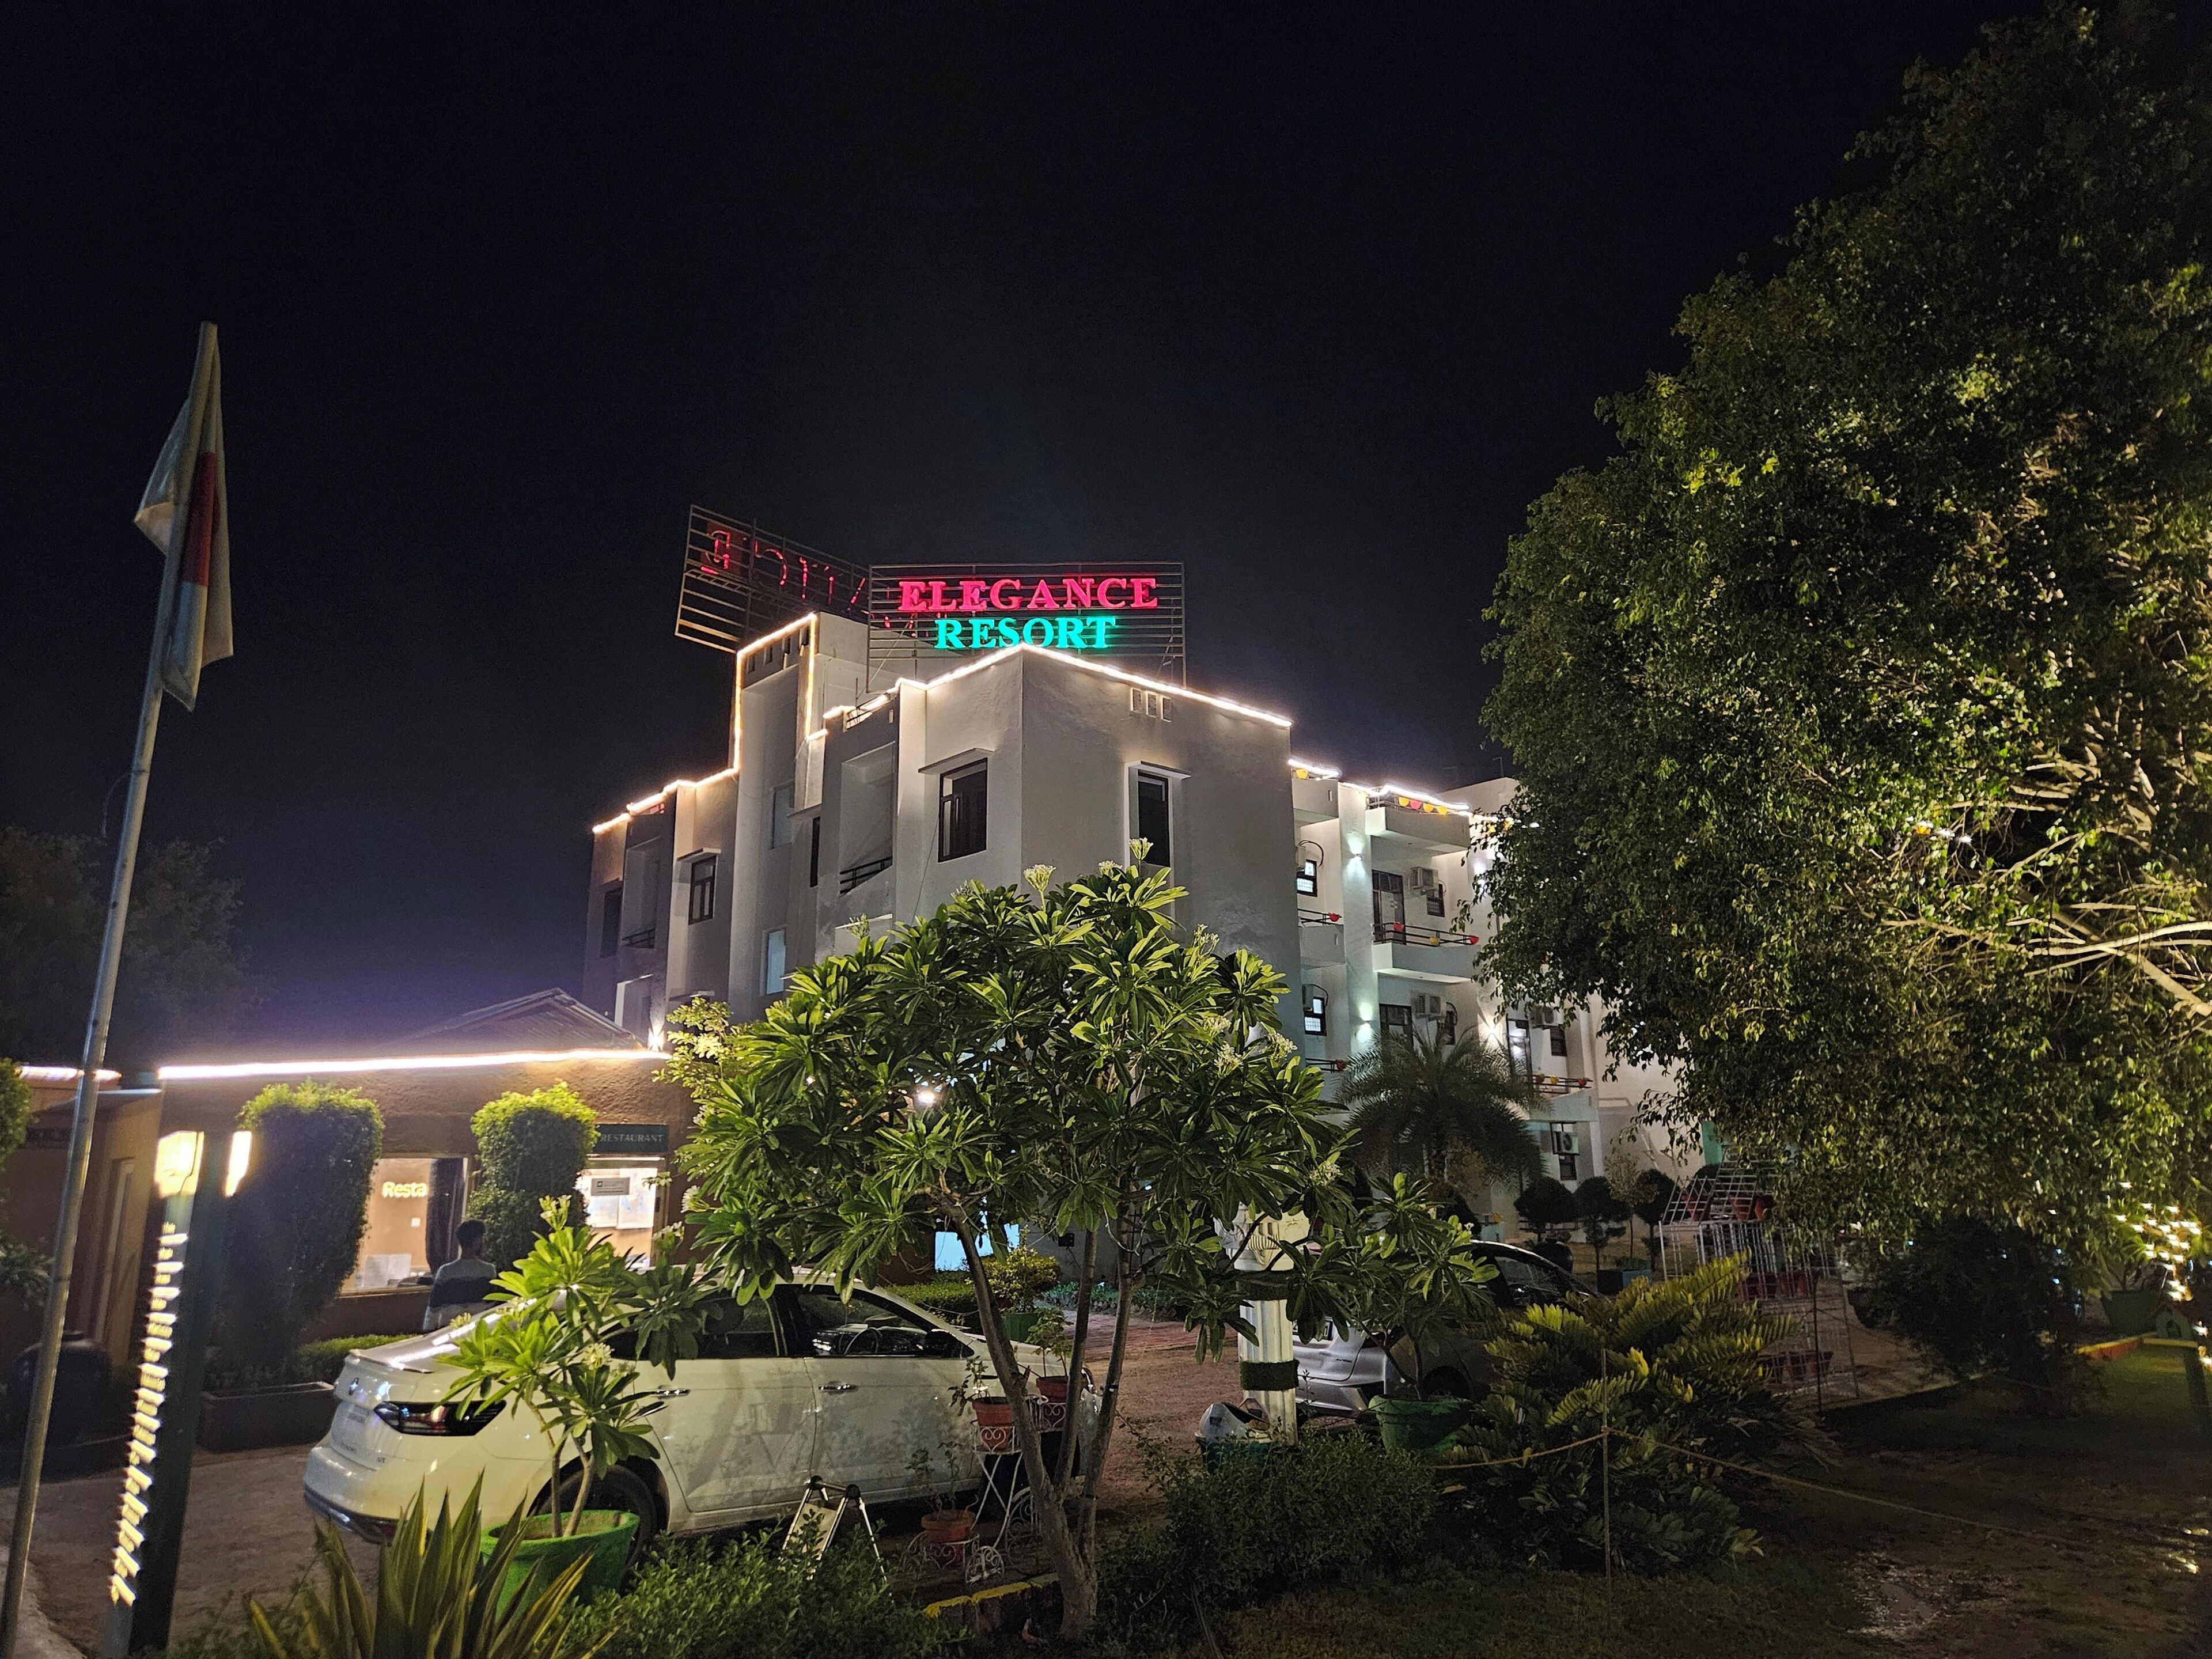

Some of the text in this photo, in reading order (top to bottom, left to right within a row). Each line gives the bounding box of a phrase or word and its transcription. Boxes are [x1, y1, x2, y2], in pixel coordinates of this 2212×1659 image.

[899, 578, 1158, 611] ELEGANCE
[934, 617, 1116, 649] RESORT
[600, 1133, 664, 1142] RESTAURANT
